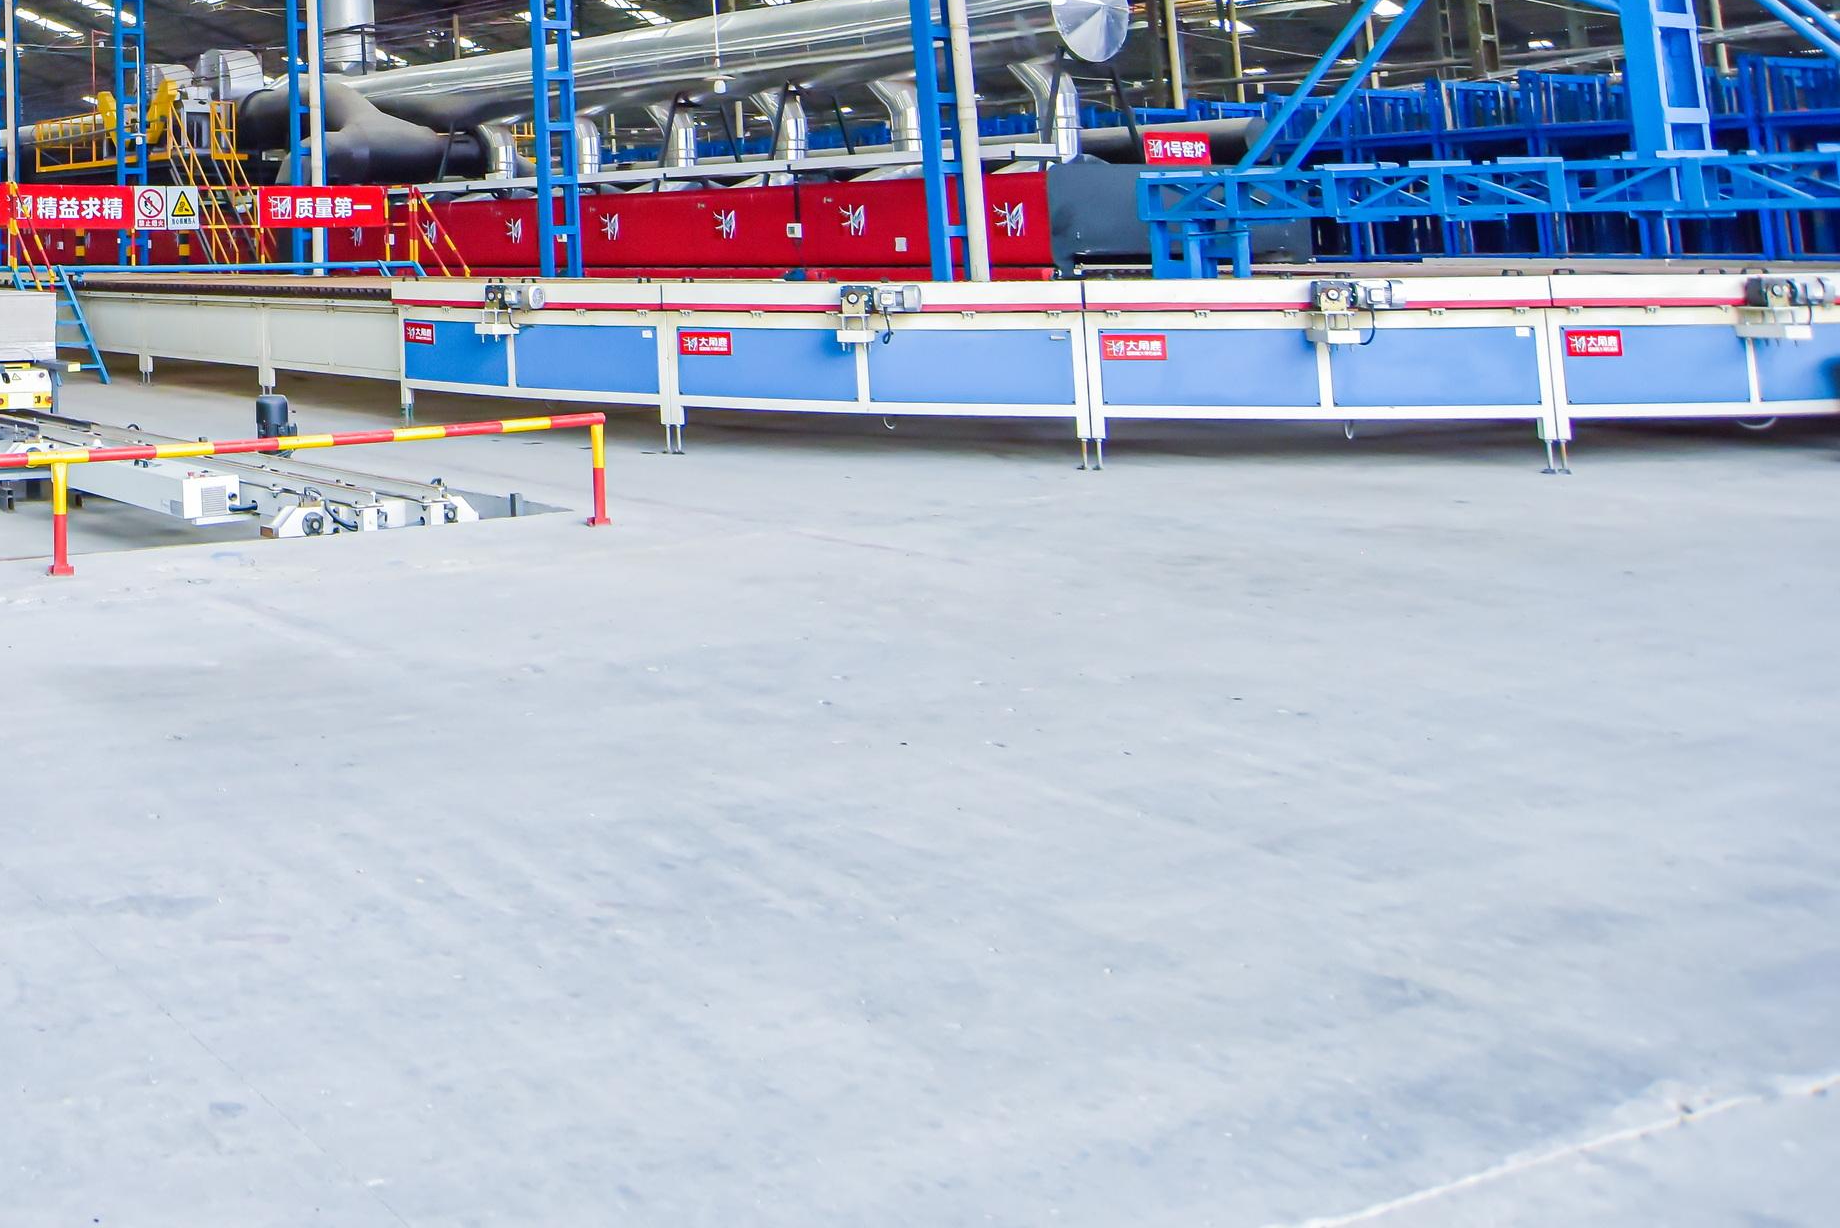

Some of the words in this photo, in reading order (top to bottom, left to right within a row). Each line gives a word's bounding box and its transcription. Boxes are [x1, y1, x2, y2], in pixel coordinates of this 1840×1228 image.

[1164, 140, 1206, 157] 1号窑炉
[37, 197, 123, 219] 精益求精
[295, 197, 372, 218] 质量第一
[1126, 340, 1162, 350] 大角鹿
